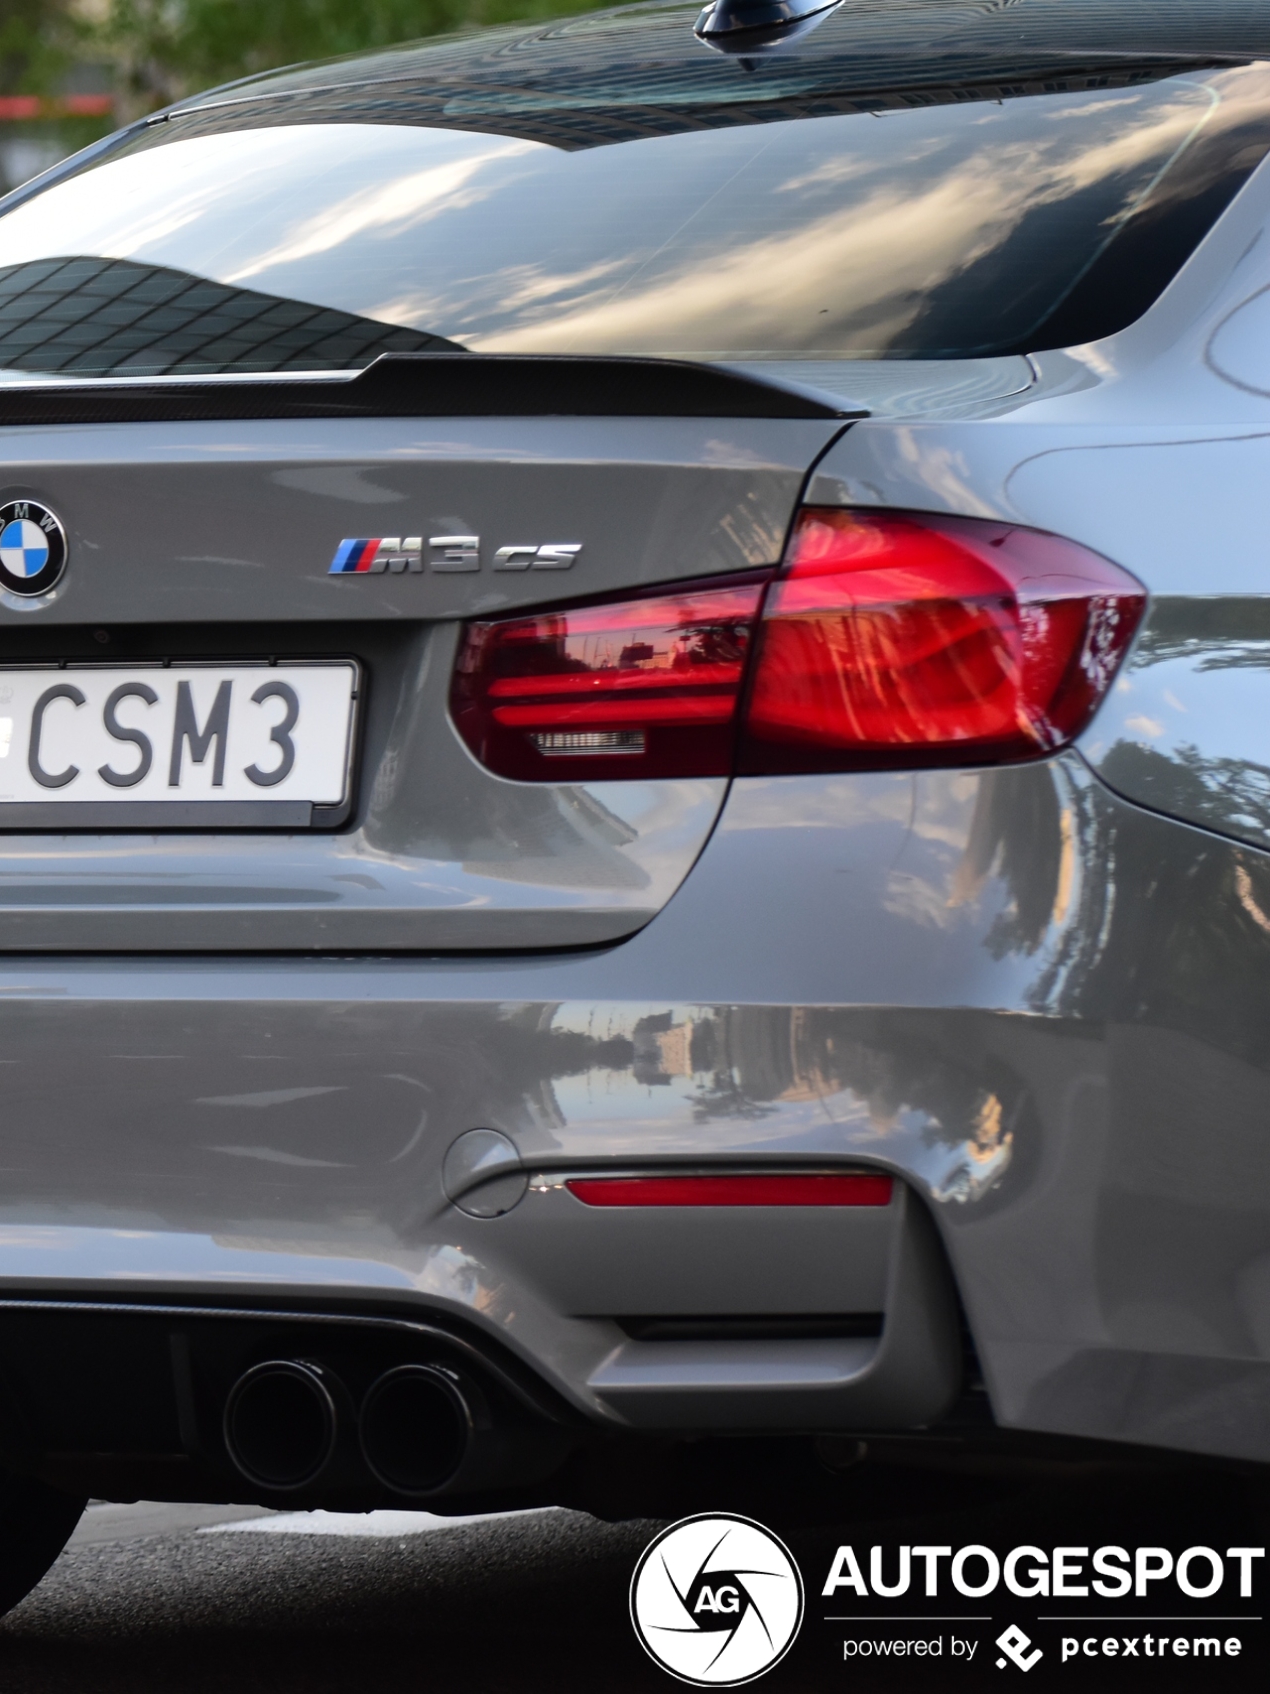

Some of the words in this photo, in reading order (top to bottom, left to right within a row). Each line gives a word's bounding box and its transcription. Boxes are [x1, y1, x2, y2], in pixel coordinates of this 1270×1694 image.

[366, 536, 481, 574] M3
[492, 544, 583, 571] CS
[28, 681, 299, 789] CSM3
